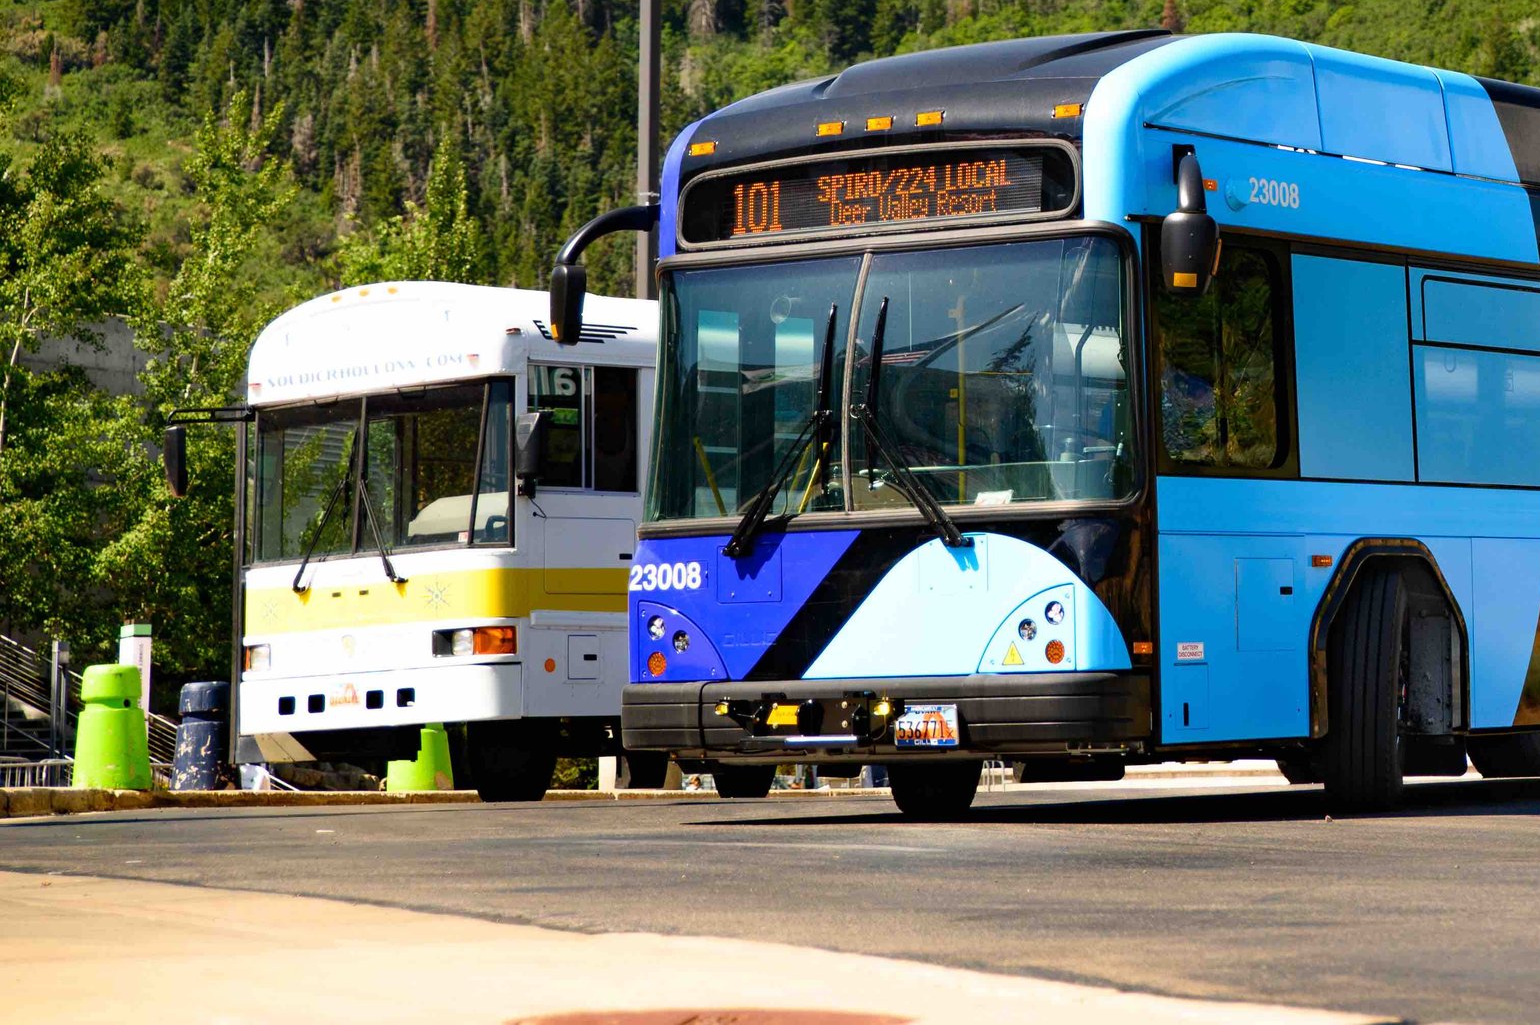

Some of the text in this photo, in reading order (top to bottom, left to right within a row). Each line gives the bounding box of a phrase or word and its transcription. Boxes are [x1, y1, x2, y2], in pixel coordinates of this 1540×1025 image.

[816, 159, 1011, 202] SPIRO/224 LOCAL
[1249, 176, 1300, 209] 23008
[733, 181, 782, 235] 101
[829, 189, 997, 226] Deer Valley Resort
[628, 561, 702, 592] 23008
